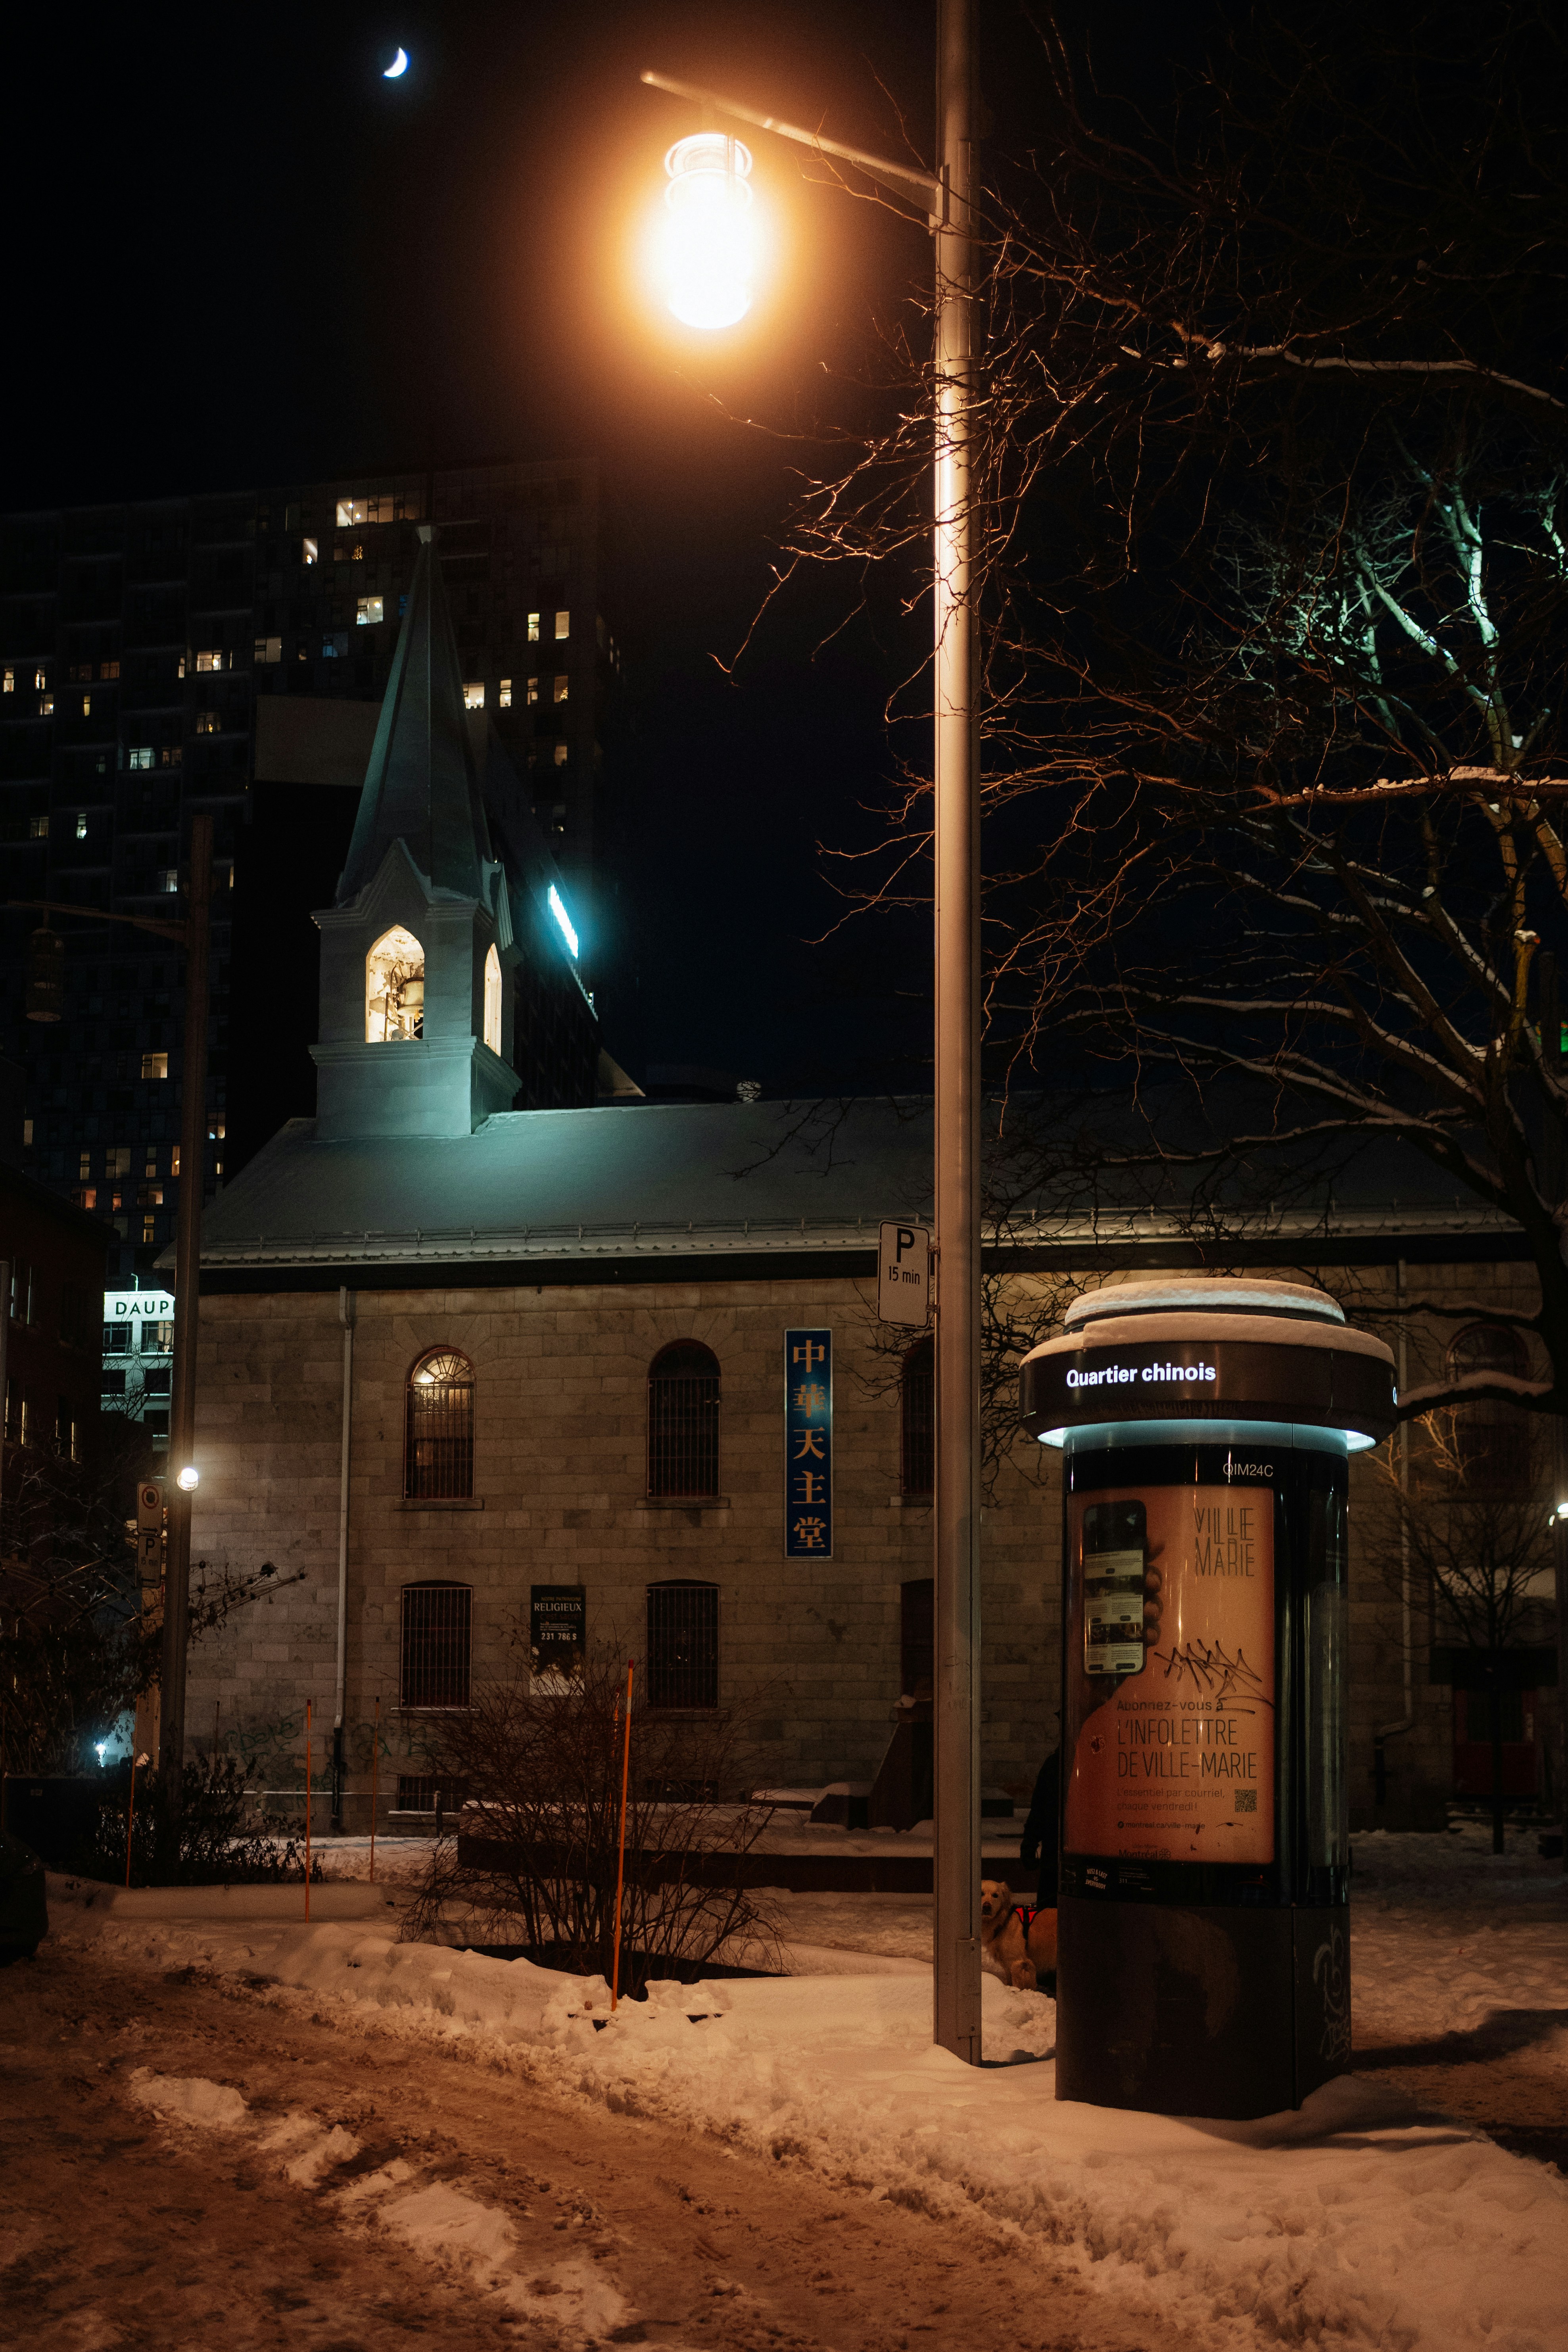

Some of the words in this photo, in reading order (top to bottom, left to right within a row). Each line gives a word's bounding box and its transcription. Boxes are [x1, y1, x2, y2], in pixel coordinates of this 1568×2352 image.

[896, 1227, 915, 1263] P
[889, 1266, 899, 1281] 15
[902, 1270, 920, 1285] min
[1066, 1365, 1138, 1388] Quartier
[1142, 1362, 1216, 1381] chinois
[793, 1339, 827, 1548] 中華天主堂
[1223, 1463, 1274, 1477] QIM24C
[1193, 1507, 1254, 1544] VILLE
[146, 1537, 155, 1555] P
[1195, 1536, 1255, 1576] MARIE
[534, 1603, 582, 1611] RELIGIEUX
[1117, 1699, 1212, 1711] Abonnez-vous
[1118, 1718, 1238, 1745] L'INFOLETTRE
[1118, 1751, 1138, 1777] DE
[1142, 1751, 1257, 1778] VILLE-MARIE
[1166, 1789, 1182, 1798] par
[1117, 1803, 1149, 1812] chaque
